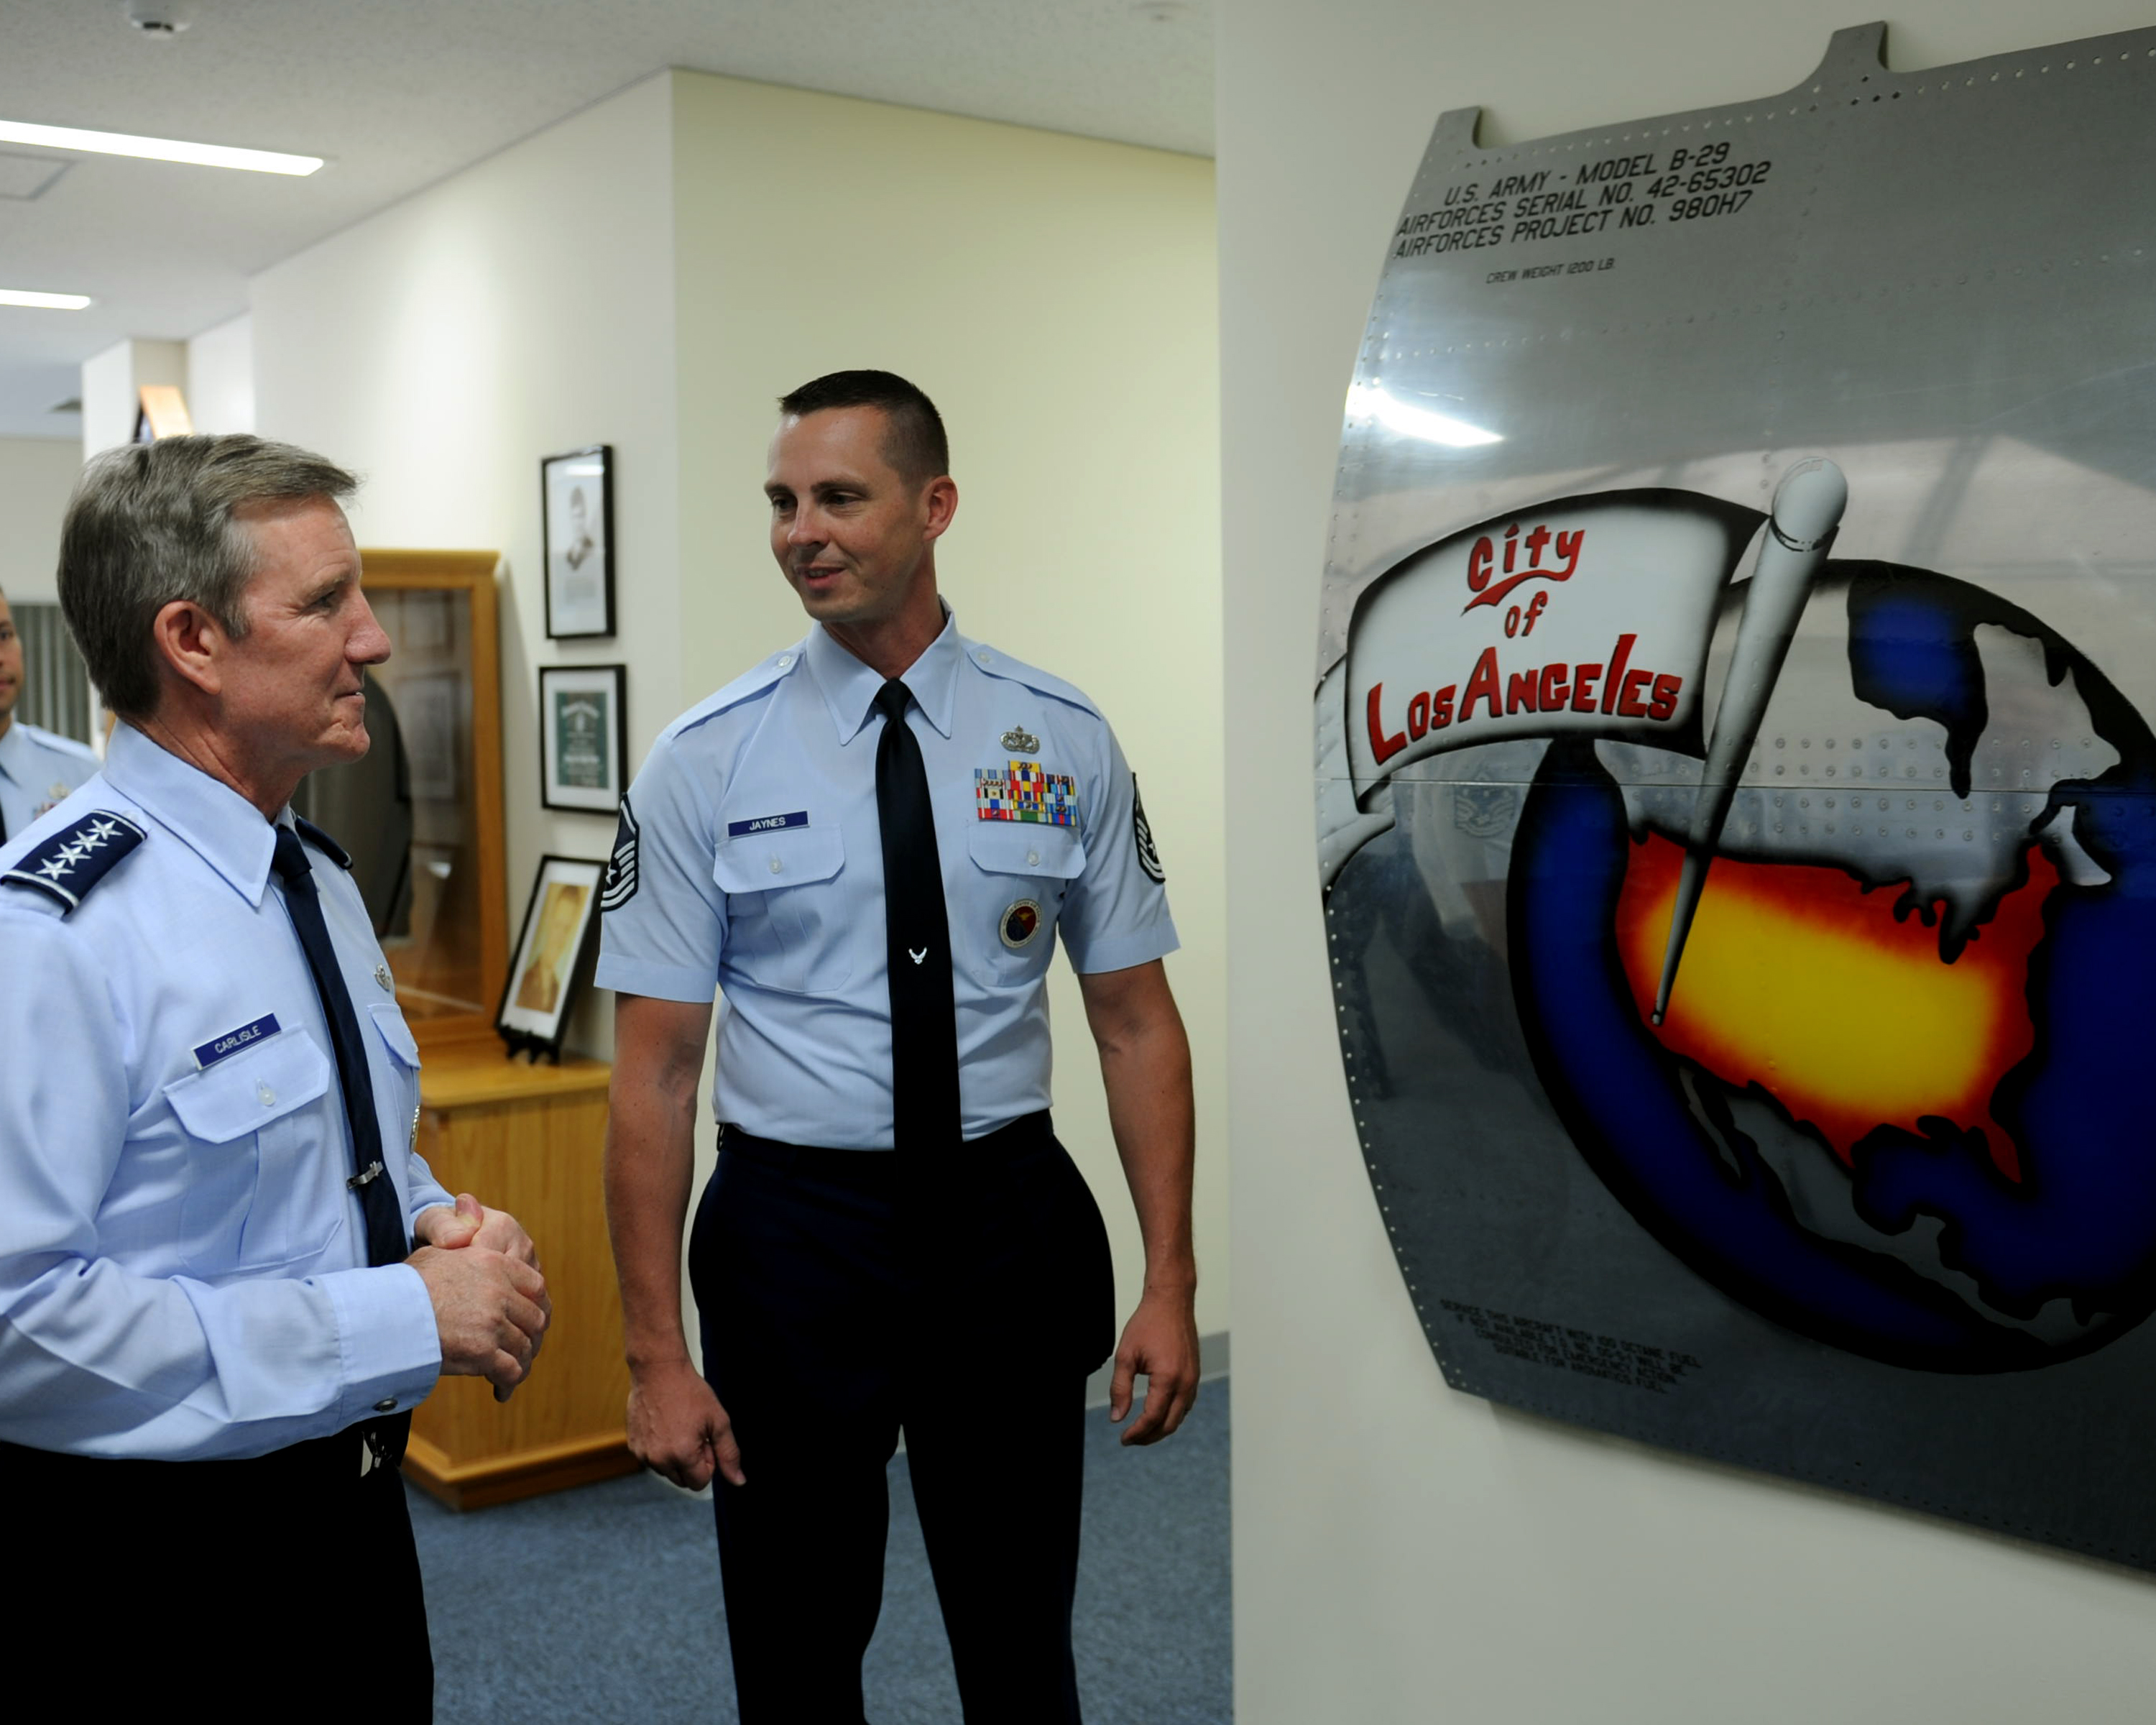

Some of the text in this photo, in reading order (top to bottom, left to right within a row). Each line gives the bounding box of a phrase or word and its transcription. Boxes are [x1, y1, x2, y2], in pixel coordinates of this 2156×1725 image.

[1396, 160, 1772, 236] AIRFORCES SERIAL NO. 42-65302
[1445, 183, 1479, 206] U.S.
[1488, 170, 1552, 199] ARMY
[1576, 154, 1657, 185] MODEL
[1669, 142, 1731, 171] B-29
[1394, 189, 1754, 259] AIRFORCES PROJECT NO. 980H7
[1486, 270, 1518, 284] CREW
[1521, 263, 1565, 280] WEIGHT
[1567, 259, 1595, 275] 1200
[1461, 523, 1585, 615] City
[1505, 590, 1548, 638] of
[749, 816, 786, 831] JAYNES
[214, 1025, 262, 1054] CARLISLE
